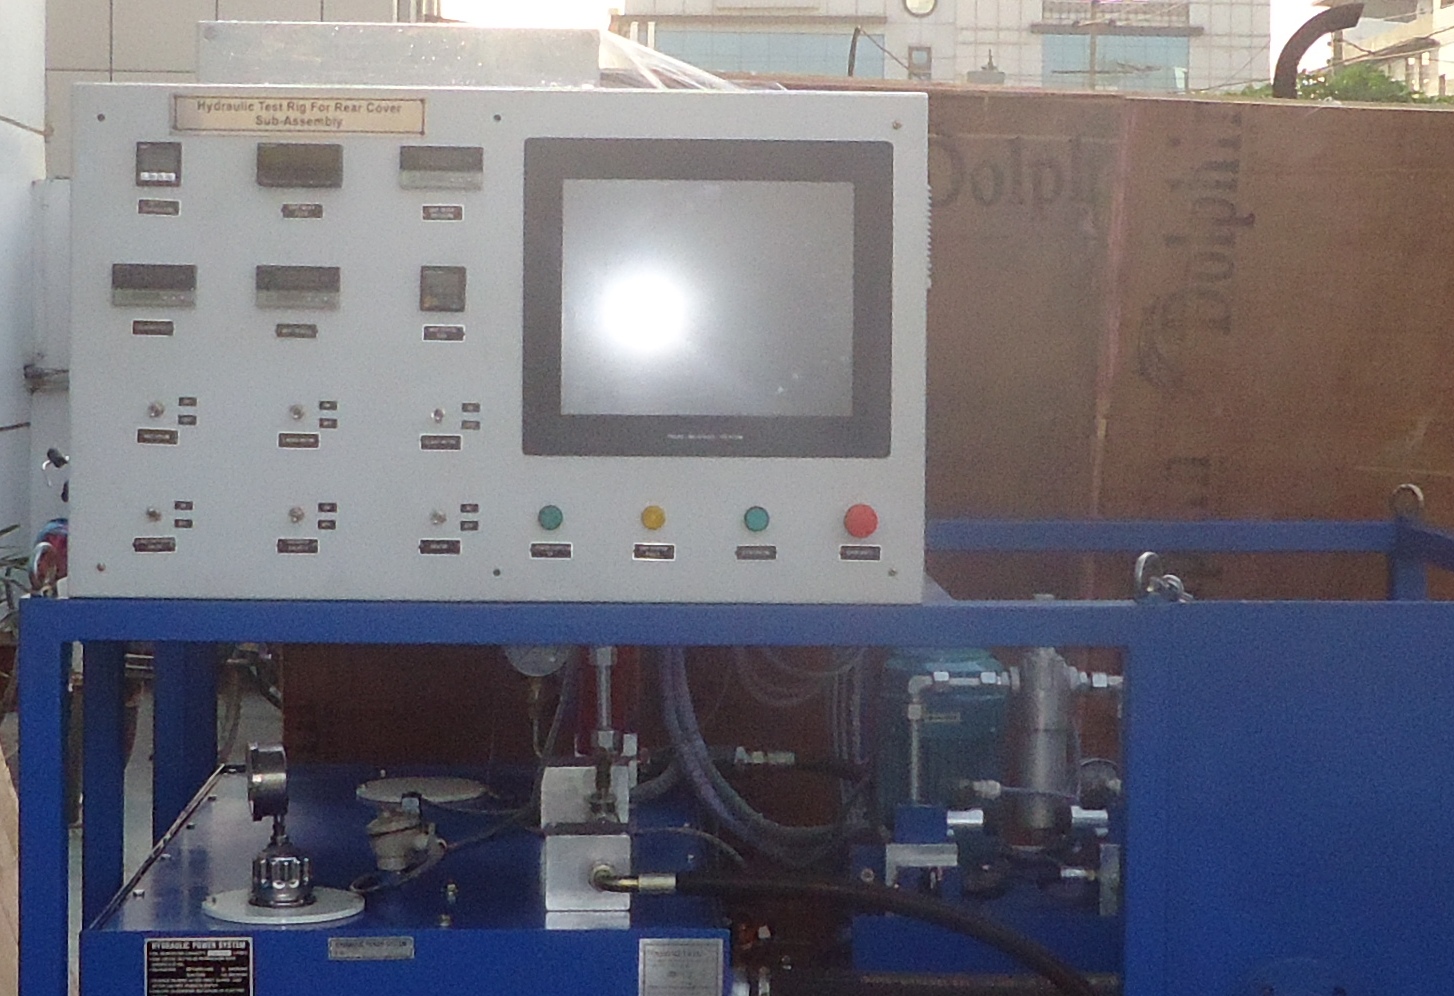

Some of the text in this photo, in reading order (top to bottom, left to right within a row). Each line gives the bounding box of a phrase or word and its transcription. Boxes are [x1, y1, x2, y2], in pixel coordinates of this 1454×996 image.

[197, 101, 402, 115] Hydraulic Test Rig For Rear Cover
[255, 115, 344, 129] Sub-Assembly
